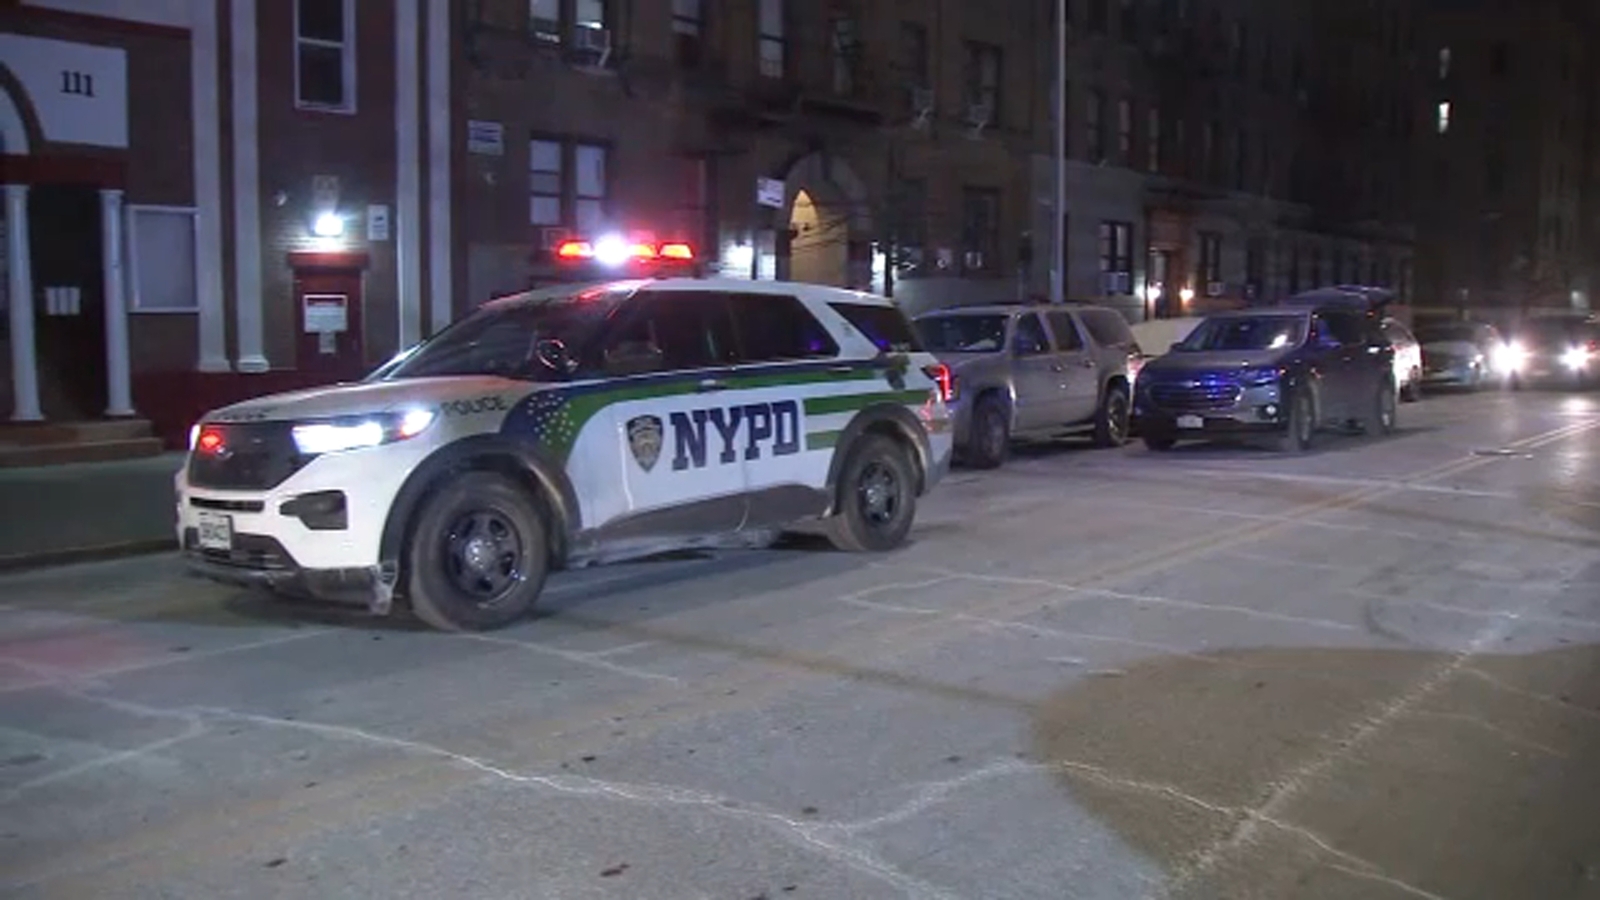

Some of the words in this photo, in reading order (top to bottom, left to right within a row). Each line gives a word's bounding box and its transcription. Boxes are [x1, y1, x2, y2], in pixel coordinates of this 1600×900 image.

[60, 70, 95, 98] 111
[441, 396, 507, 417] POLICE
[669, 400, 800, 471] NYPD
